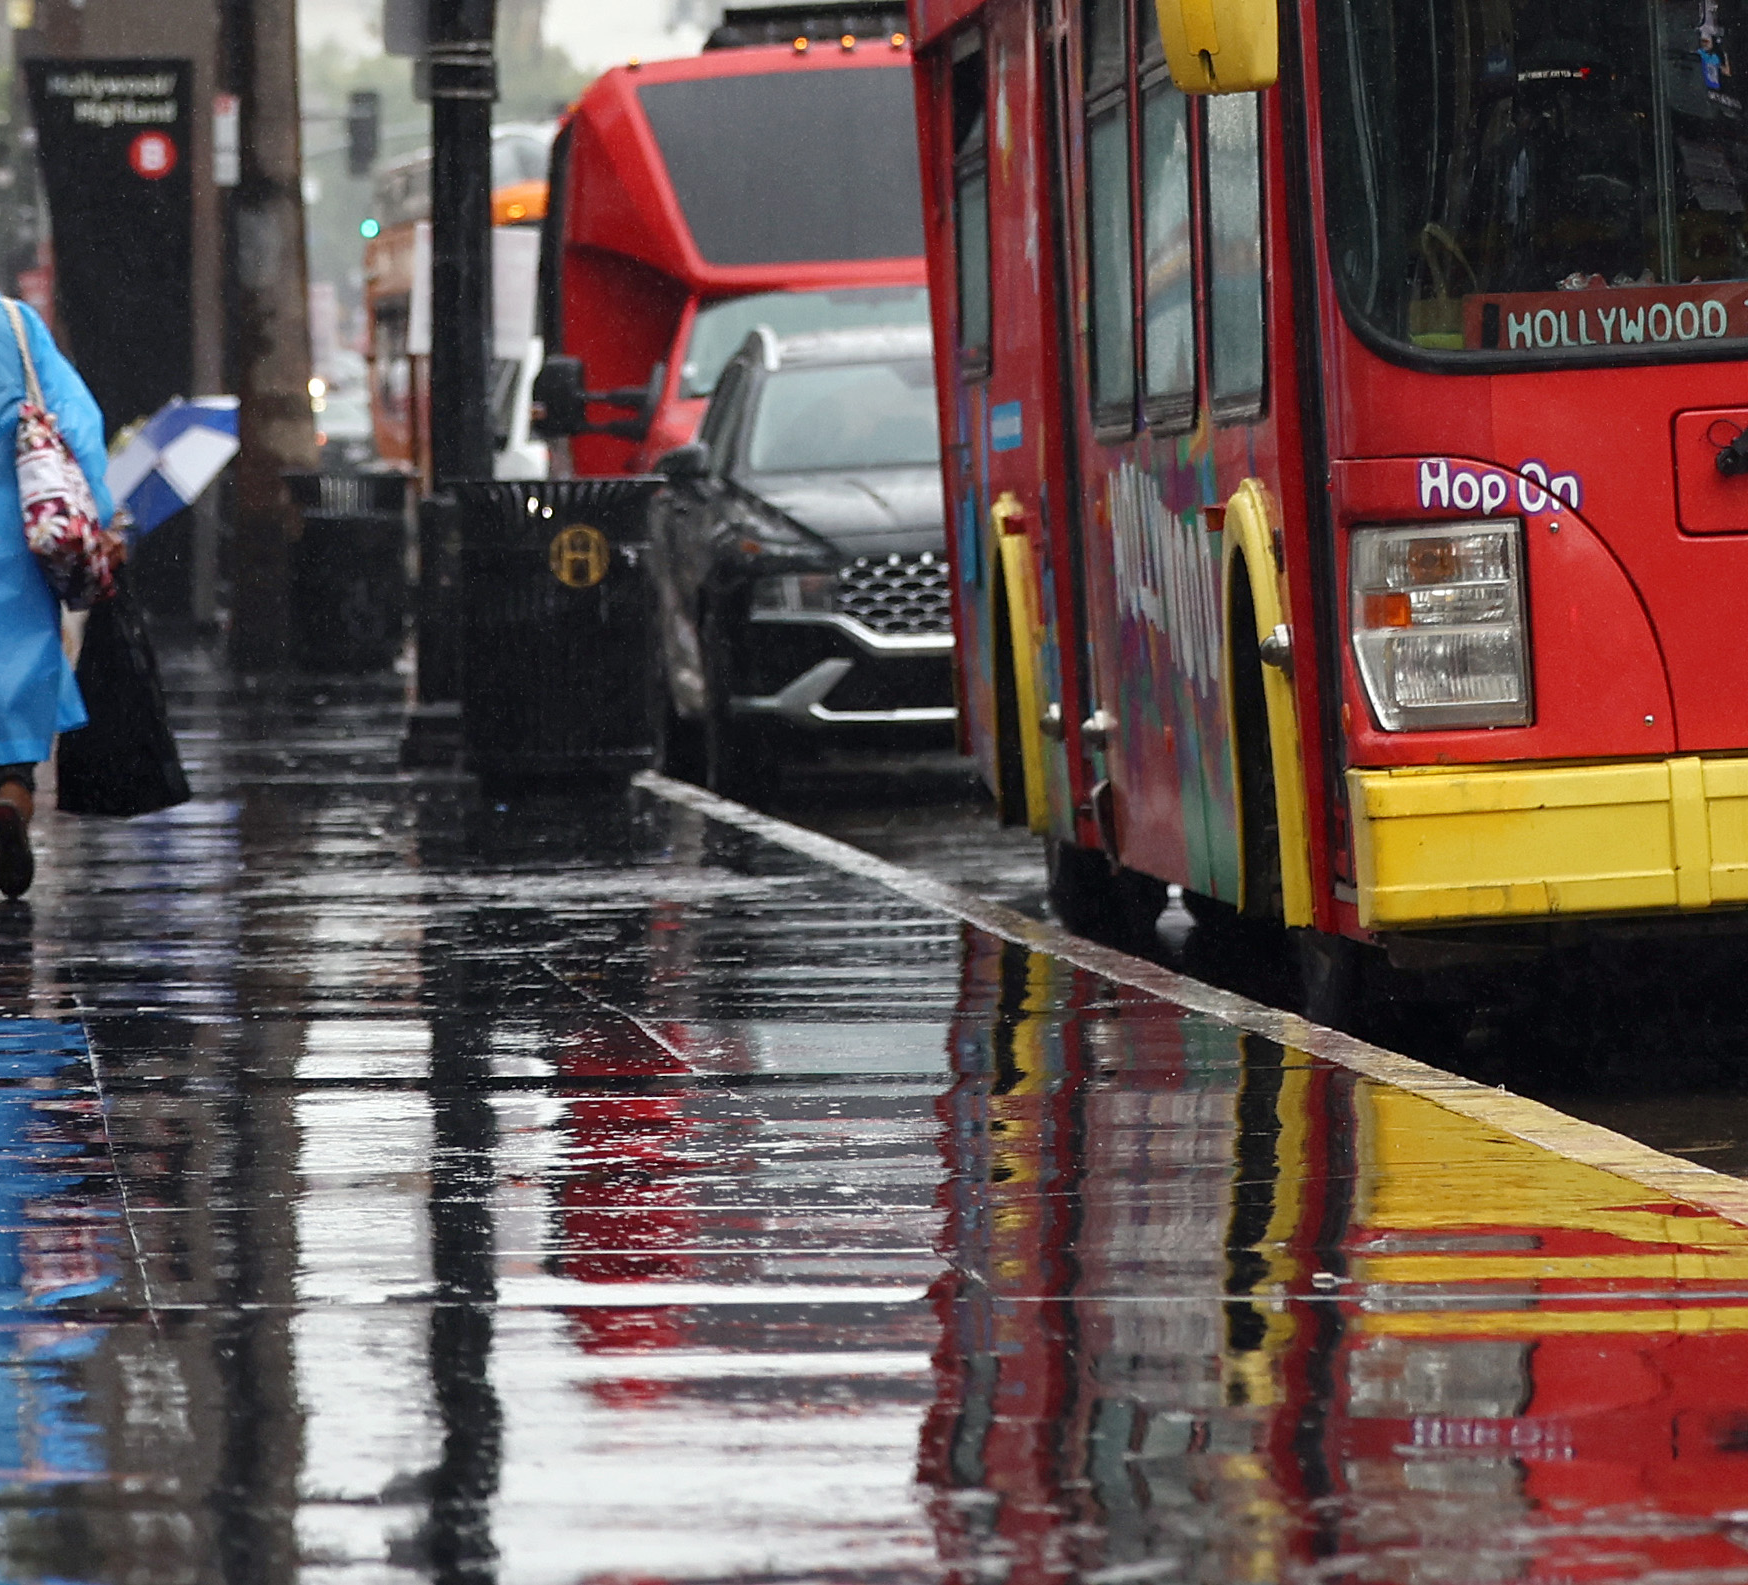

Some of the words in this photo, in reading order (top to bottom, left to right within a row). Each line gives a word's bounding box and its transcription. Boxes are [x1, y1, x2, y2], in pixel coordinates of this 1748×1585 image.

[1507, 299, 1729, 350] HOLLYWOOD
[1420, 460, 1507, 516] Hop
[1518, 462, 1579, 513] On
